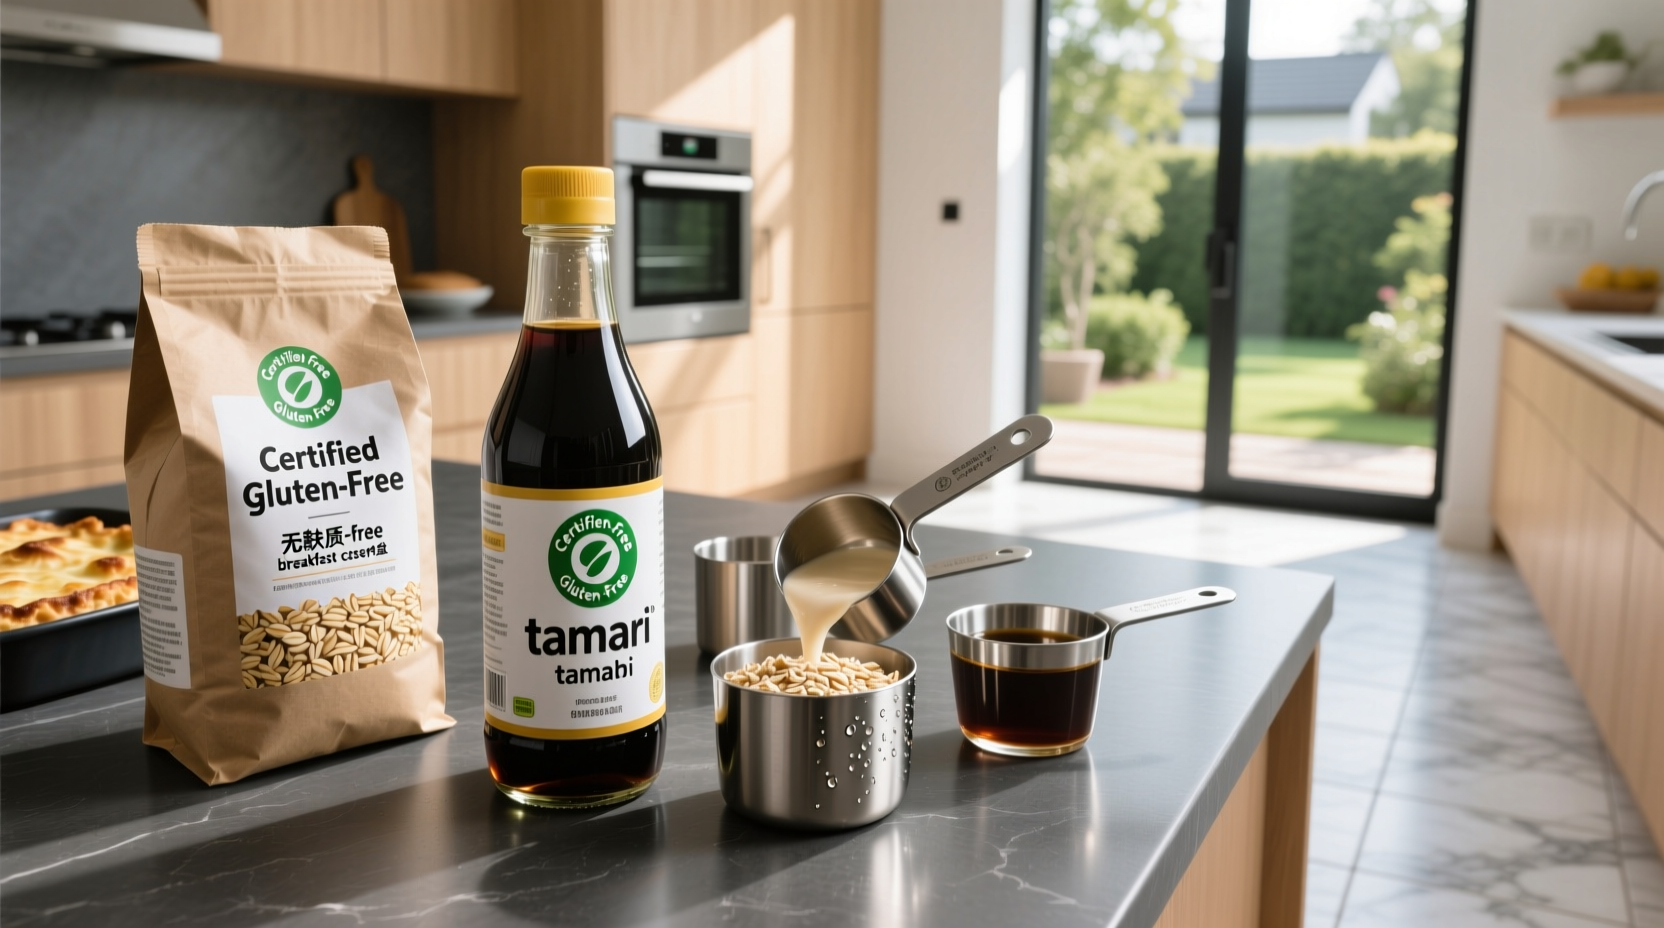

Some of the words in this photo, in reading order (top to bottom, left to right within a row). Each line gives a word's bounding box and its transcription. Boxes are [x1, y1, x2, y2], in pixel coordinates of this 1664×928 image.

[273, 400, 314, 423] Gluten
[312, 398, 335, 419] Free
[259, 435, 380, 472] Certified
[242, 469, 404, 517] Gluten-Free
[560, 575, 601, 602] Gluten
[524, 606, 650, 656] tamari
